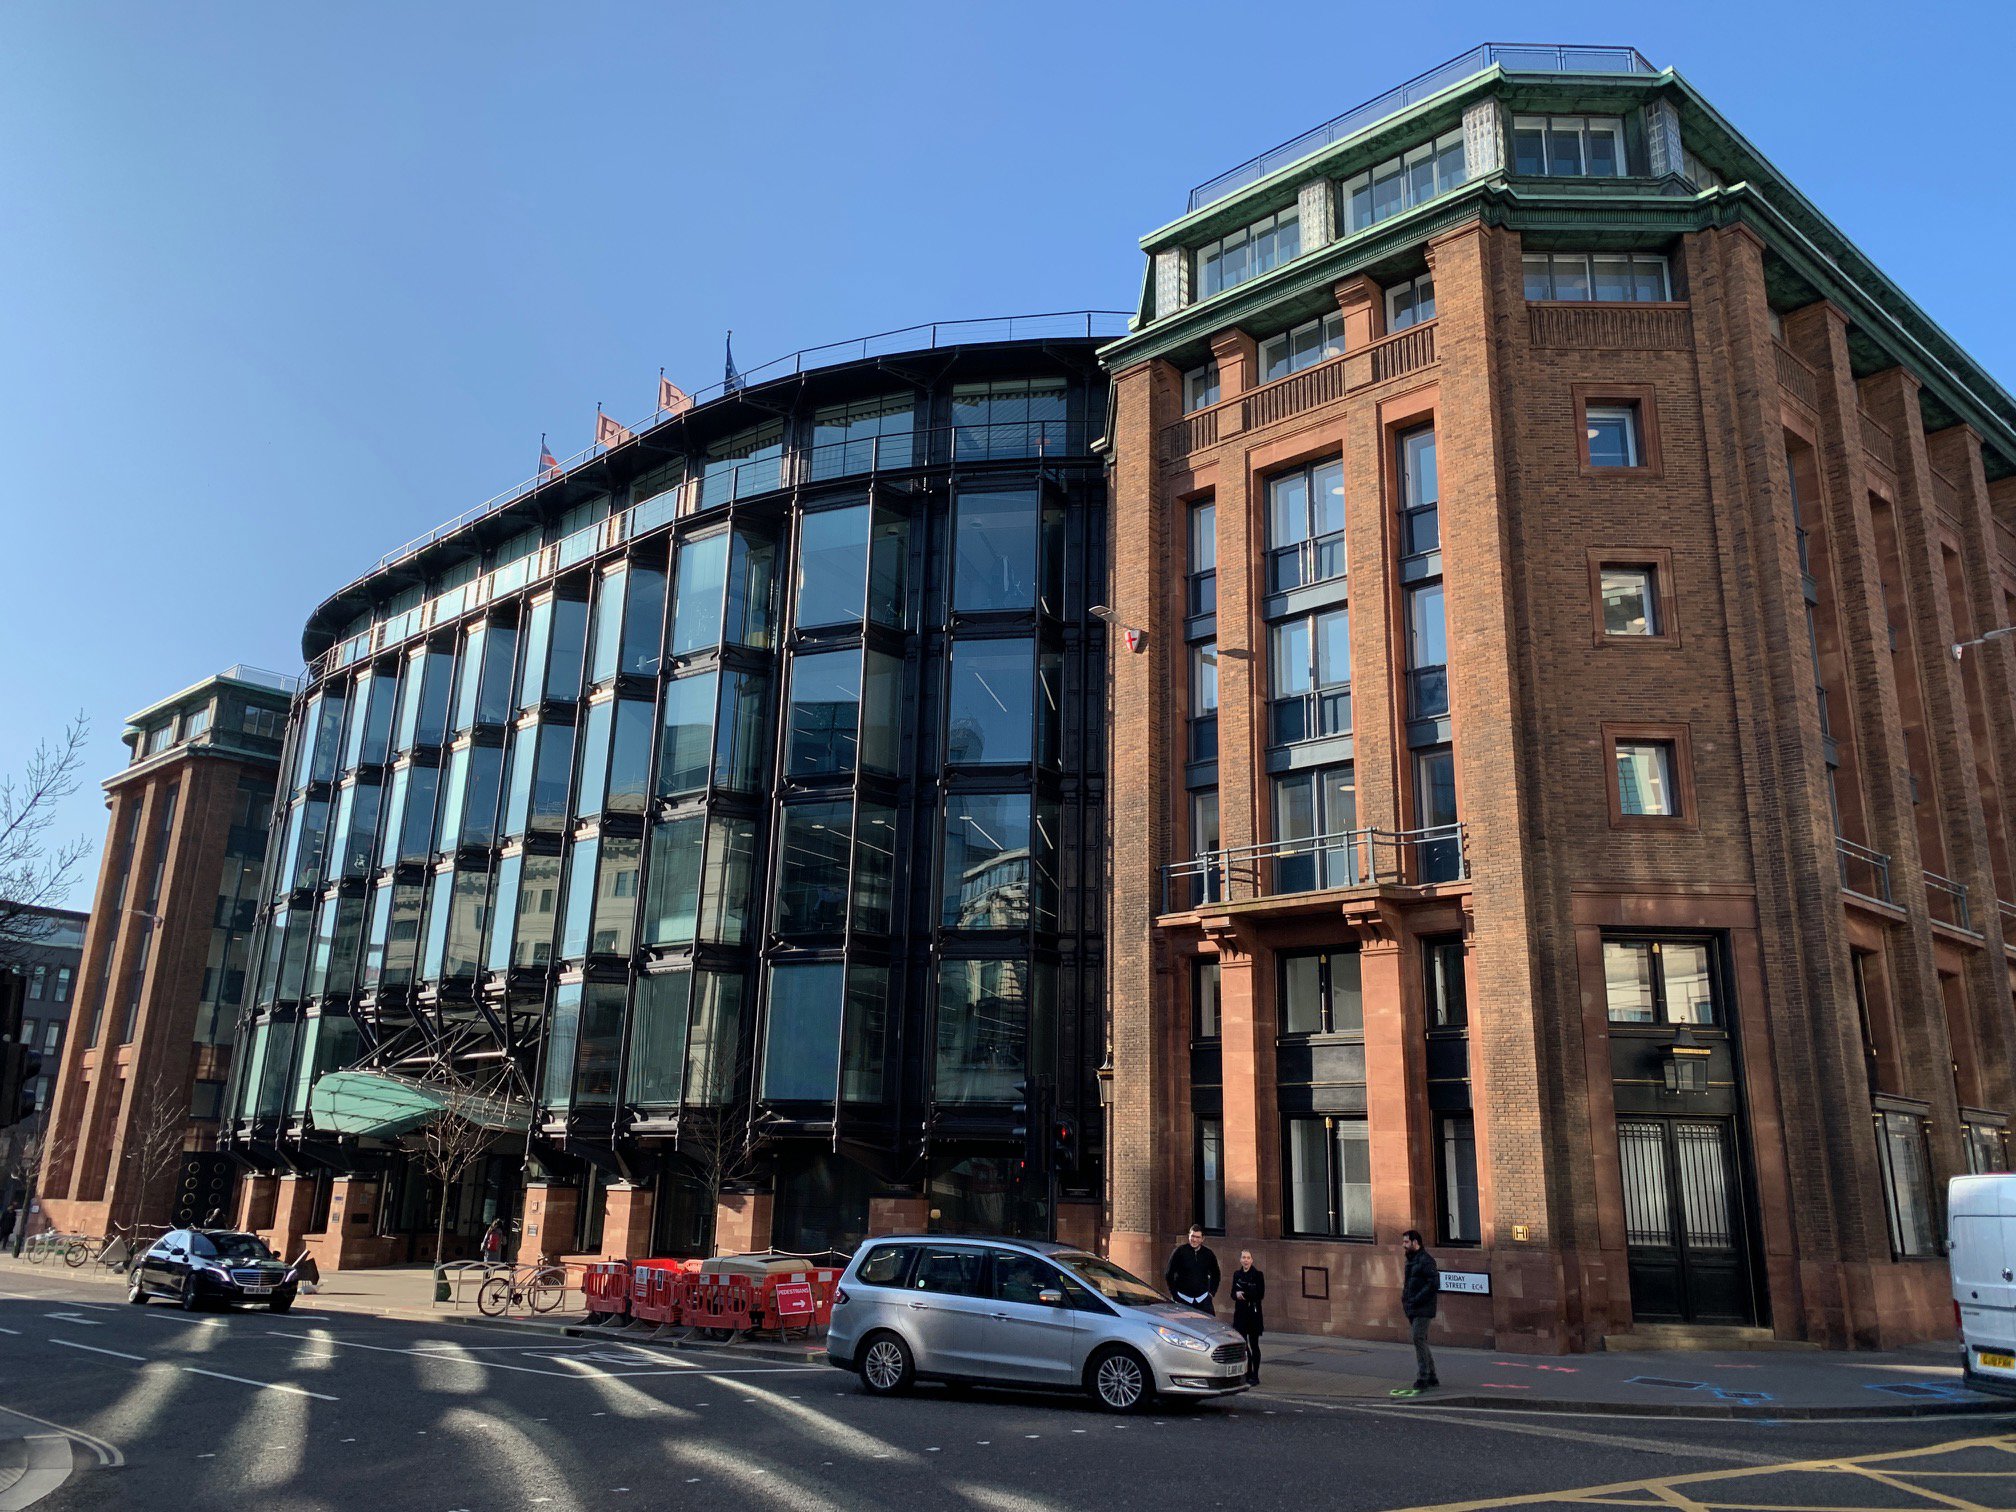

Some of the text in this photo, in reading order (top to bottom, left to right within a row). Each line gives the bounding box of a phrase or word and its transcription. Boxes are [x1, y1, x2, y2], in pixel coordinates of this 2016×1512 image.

[1444, 1274, 1466, 1282] FRIDAY
[778, 1287, 809, 1295] PEDESTRIANS
[1472, 1283, 1483, 1291] EC4
